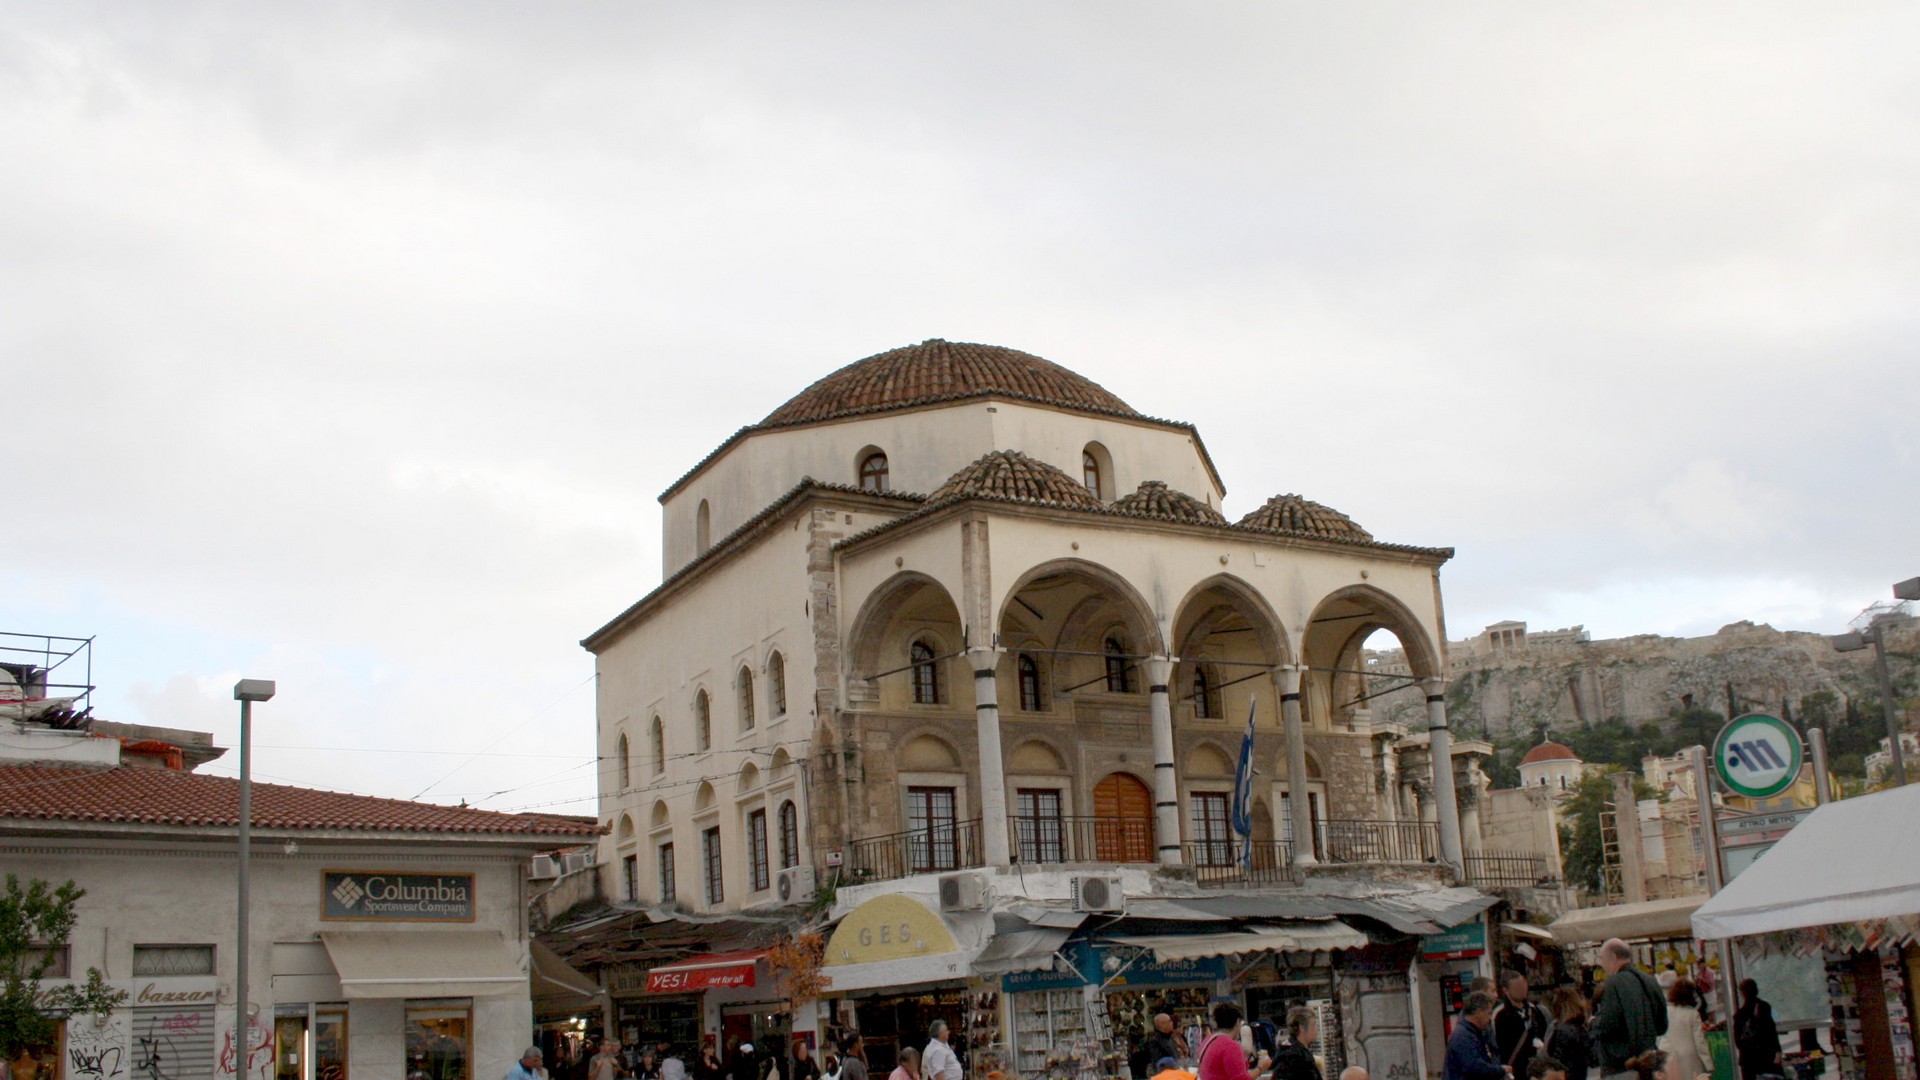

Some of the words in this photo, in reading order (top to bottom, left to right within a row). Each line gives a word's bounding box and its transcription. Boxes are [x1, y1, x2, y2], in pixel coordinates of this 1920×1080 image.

[364, 876, 467, 901] Columbia
[364, 899, 419, 914] Sportswear
[418, 900, 467, 916] Company
[859, 923, 911, 947] GES
[947, 963, 957, 973] 97
[1140, 959, 1197, 972] SOUVENIRS
[652, 972, 689, 988] YES!
[708, 976, 721, 985] art
[721, 975, 733, 984] for
[733, 974, 745, 983] all
